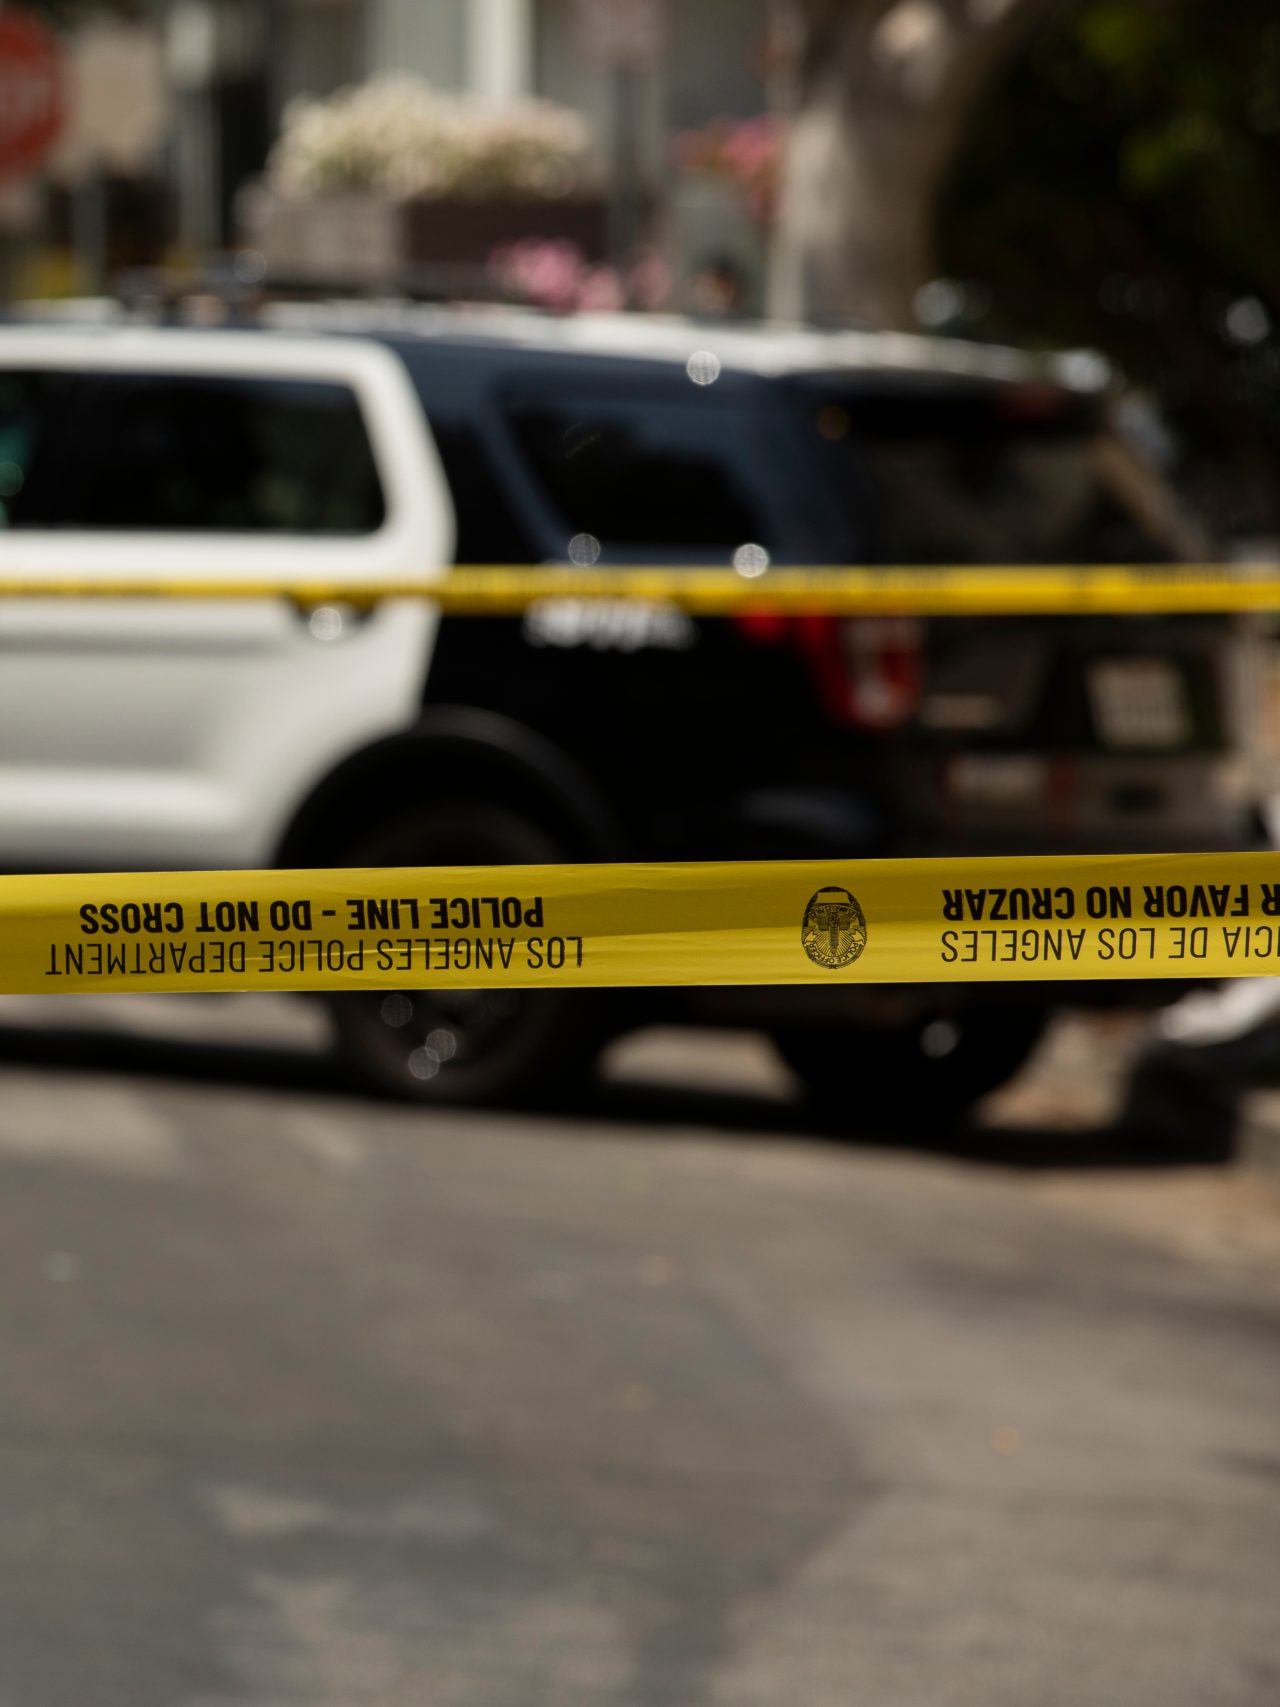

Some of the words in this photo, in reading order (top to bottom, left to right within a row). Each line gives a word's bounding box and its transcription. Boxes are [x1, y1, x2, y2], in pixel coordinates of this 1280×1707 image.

[196, 901, 259, 932] NOT
[270, 900, 312, 931] DO
[346, 898, 419, 930] LINE
[429, 897, 544, 929] POLICE
[942, 887, 1075, 921] CRUZAR
[1086, 886, 1132, 919] NO
[1142, 884, 1249, 918] FAVOR
[80, 902, 184, 934] CROSS
[45, 941, 245, 975] DEPARTMENT
[258, 939, 368, 972] POLICE
[376, 937, 515, 970] ANGELES
[527, 936, 583, 969] LOS
[941, 929, 1086, 962] ANGELES
[1098, 928, 1155, 960] LOS
[1168, 927, 1208, 958] DE
